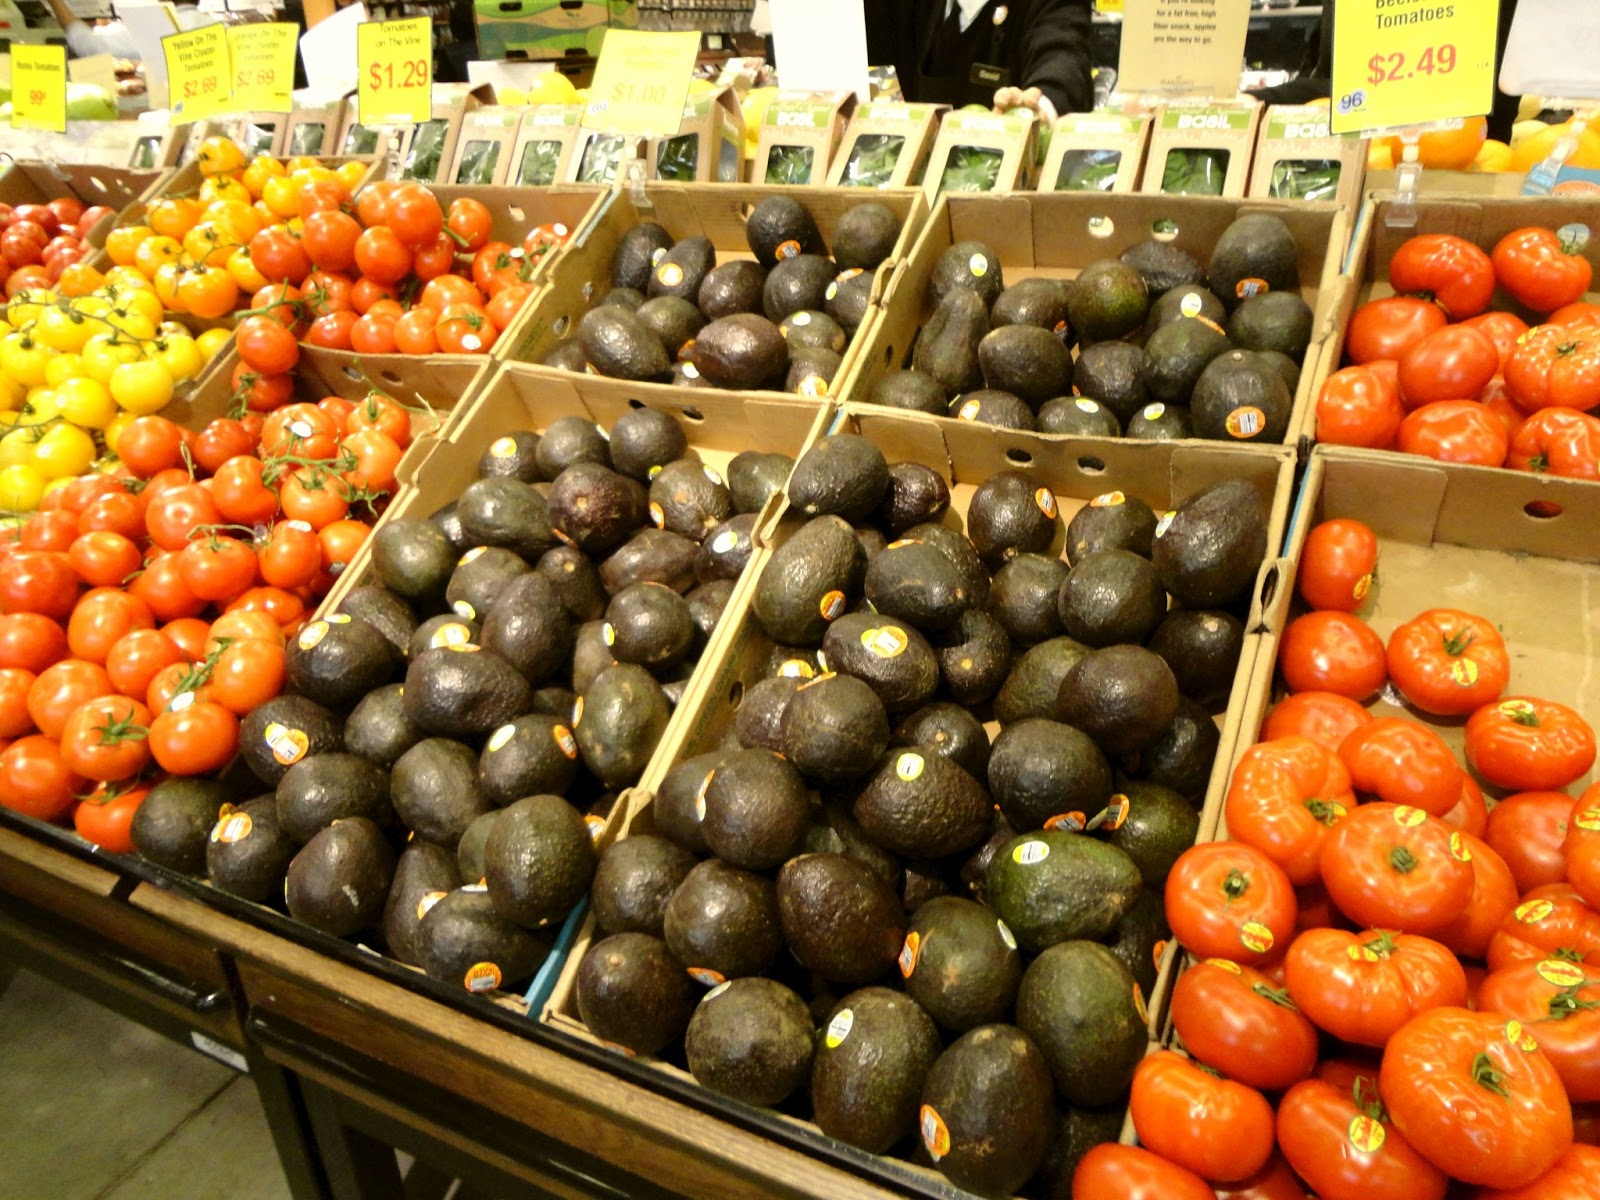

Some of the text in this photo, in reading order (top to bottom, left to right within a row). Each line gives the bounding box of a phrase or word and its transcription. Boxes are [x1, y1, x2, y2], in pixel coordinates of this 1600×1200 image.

[1375, 5, 1455, 29] Tomatoes
[379, 22, 418, 33] Tomatoes
[172, 32, 218, 51] Yellow On The
[375, 36, 421, 48] on The Vine
[178, 47, 216, 62] Vine Cluster
[184, 60, 214, 72] Tomatoes
[1367, 43, 1457, 88] $2.49
[236, 68, 276, 87] $269
[369, 59, 428, 92] $1.29
[183, 75, 217, 98] $2.69
[1341, 91, 1363, 110] 96
